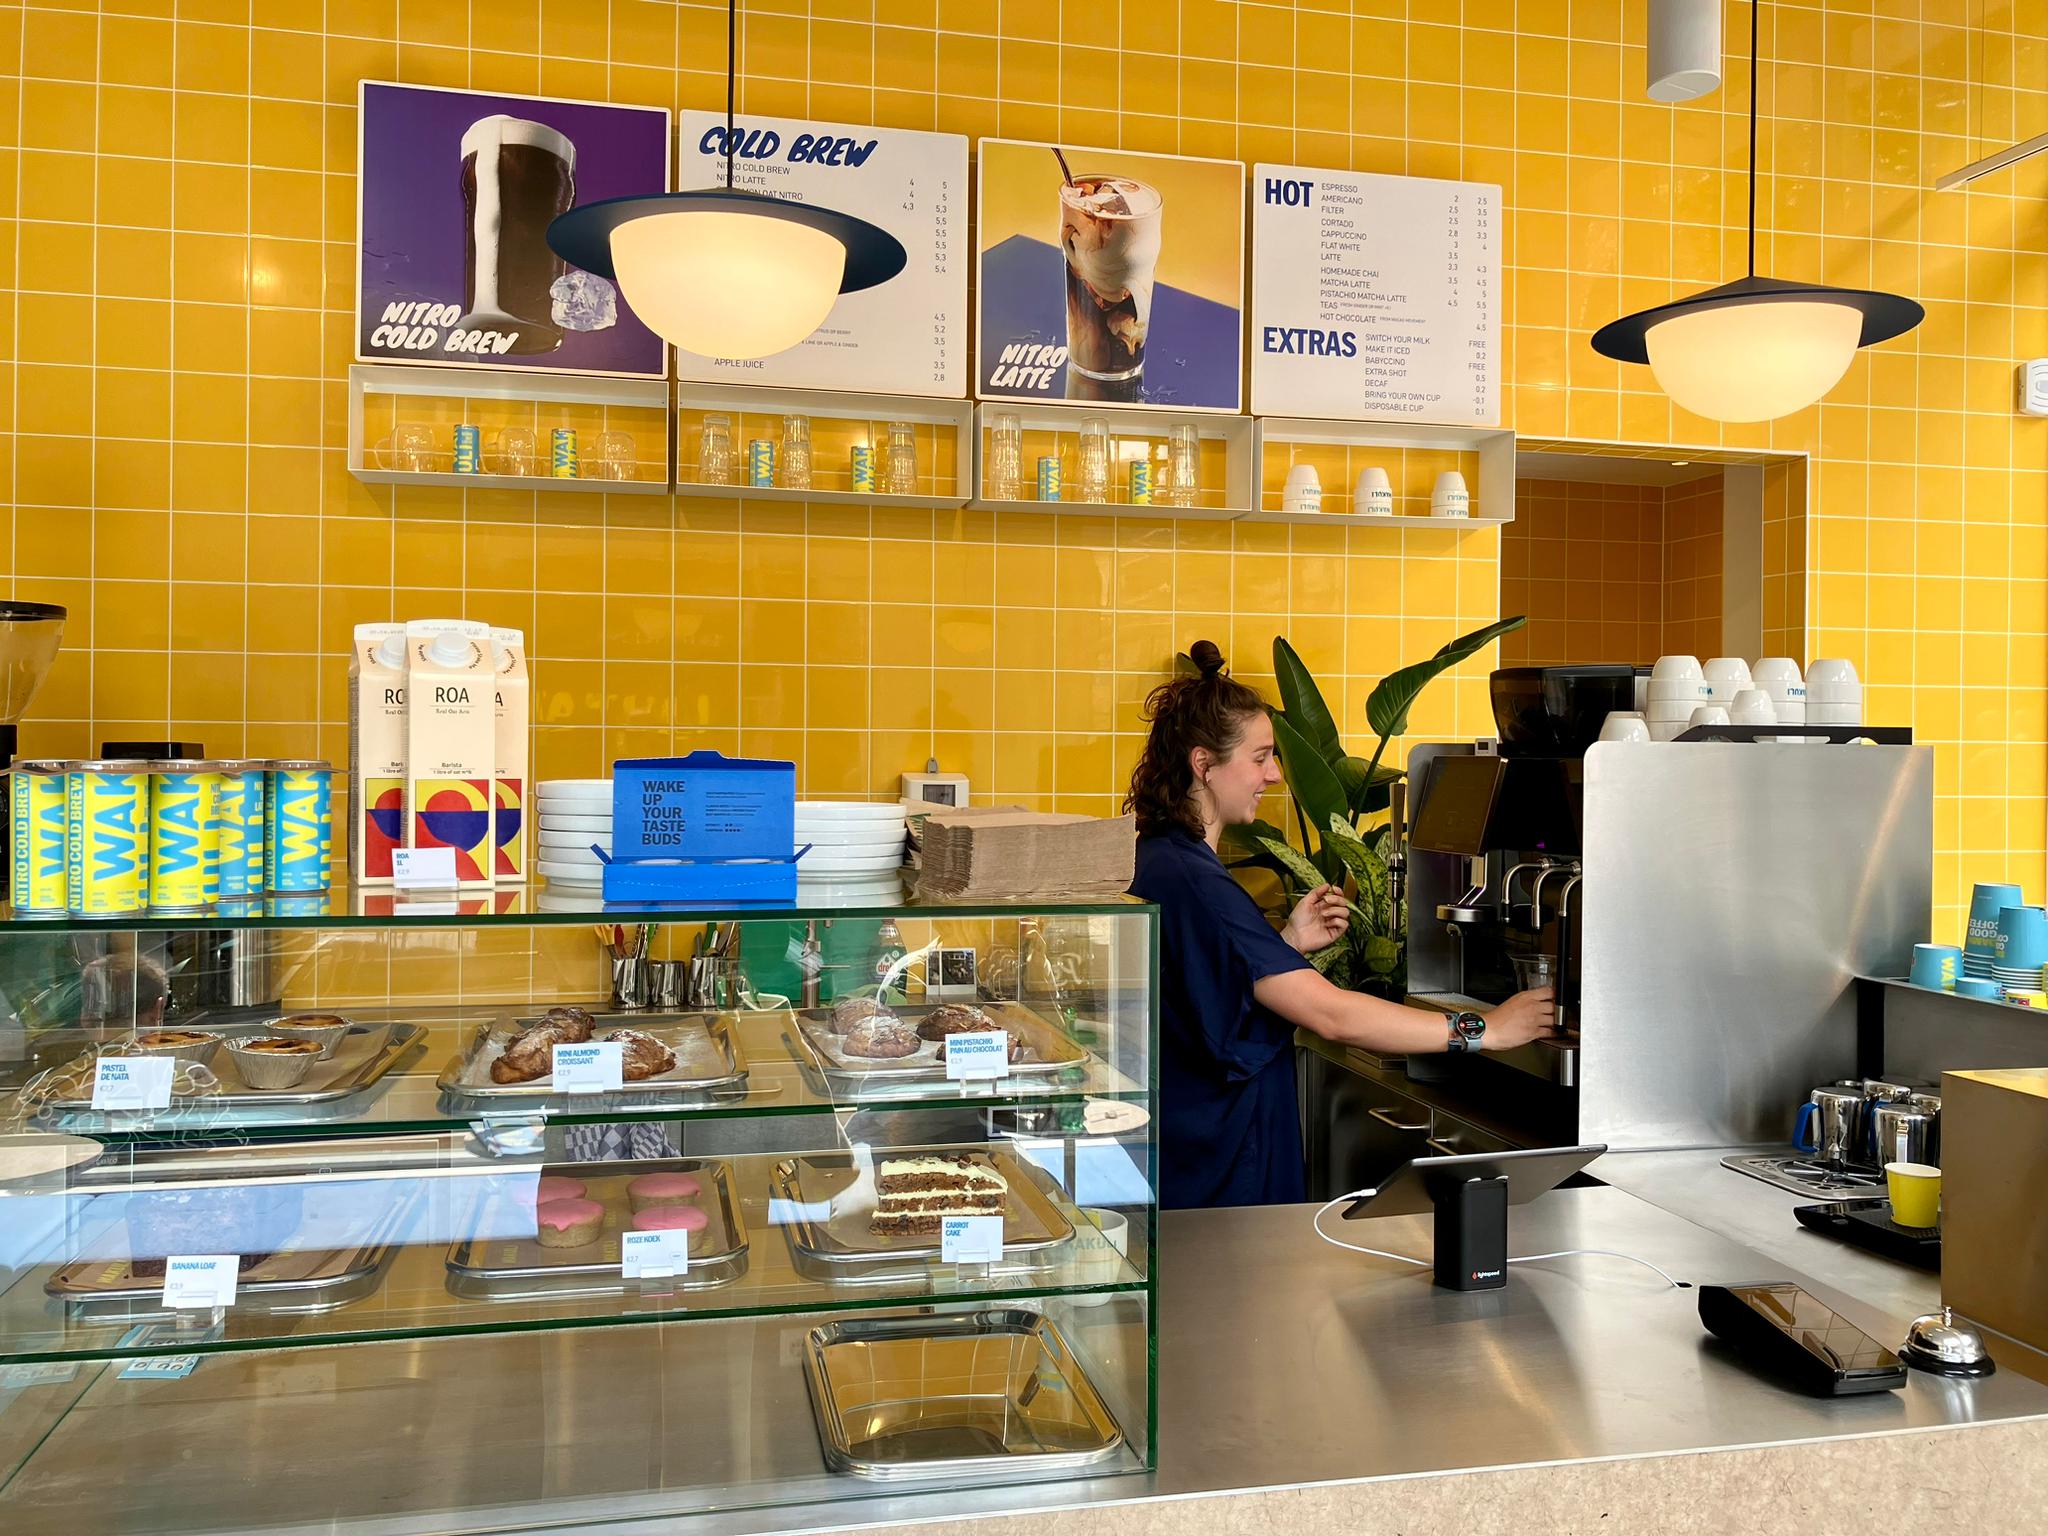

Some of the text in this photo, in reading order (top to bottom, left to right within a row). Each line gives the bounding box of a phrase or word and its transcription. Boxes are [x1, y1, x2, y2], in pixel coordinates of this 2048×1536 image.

[699, 126, 878, 167] COLD BREW
[717, 161, 790, 175] NIRO COLD BREW
[717, 173, 766, 185] NIRO LATTE
[1265, 178, 1314, 207] HOT
[1321, 183, 1358, 193] ESPRESSO
[779, 192, 803, 200] NITRO
[1321, 195, 1363, 205] AMERICANO
[903, 202, 947, 213] 4,3 5,3
[1321, 206, 1344, 214] FILTER
[1321, 218, 1354, 228] CORTADO
[1321, 230, 1367, 240] CAPPUCCINO
[1321, 242, 1360, 251] FLAT WHITE
[1321, 253, 1341, 261] LATTE
[1320, 267, 1360, 277] HOMEMADE
[1320, 279, 1370, 289] MATCHA LATTE
[1320, 290, 1407, 303] PISTACHIO MATCHA LATTE
[1320, 301, 1338, 309] TEAS
[381, 302, 462, 328] NITRO
[1335, 314, 1376, 323] CHOCOLATE
[370, 325, 519, 354] COLD BREW
[1264, 326, 1357, 358] EXTRAS
[1366, 333, 1430, 344] SWITCH YOUR MILK
[1366, 346, 1384, 354] MAKE
[999, 344, 1068, 368] NITRO
[1366, 357, 1405, 366] BABYCCINO
[714, 358, 764, 369] APPLE JUICE
[990, 366, 1056, 389] LATTE
[1365, 391, 1386, 399] BRING
[1388, 392, 1407, 400] YOUR
[1365, 402, 1407, 411] DISPOSABLE
[385, 688, 403, 704] RO
[436, 687, 470, 703] ROA
[643, 780, 686, 792] WAKE
[642, 794, 662, 806] UP
[642, 807, 682, 819] YOUR
[642, 820, 686, 832] TASTE
[16, 776, 29, 906] NITRO COLD BREW
[69, 776, 82, 910] NITRO COLD BREW
[642, 834, 681, 846] BUDS
[265, 849, 273, 886] NITRO
[1970, 928, 1997, 938] GOOD
[558, 1057, 593, 1065] CROISSANT
